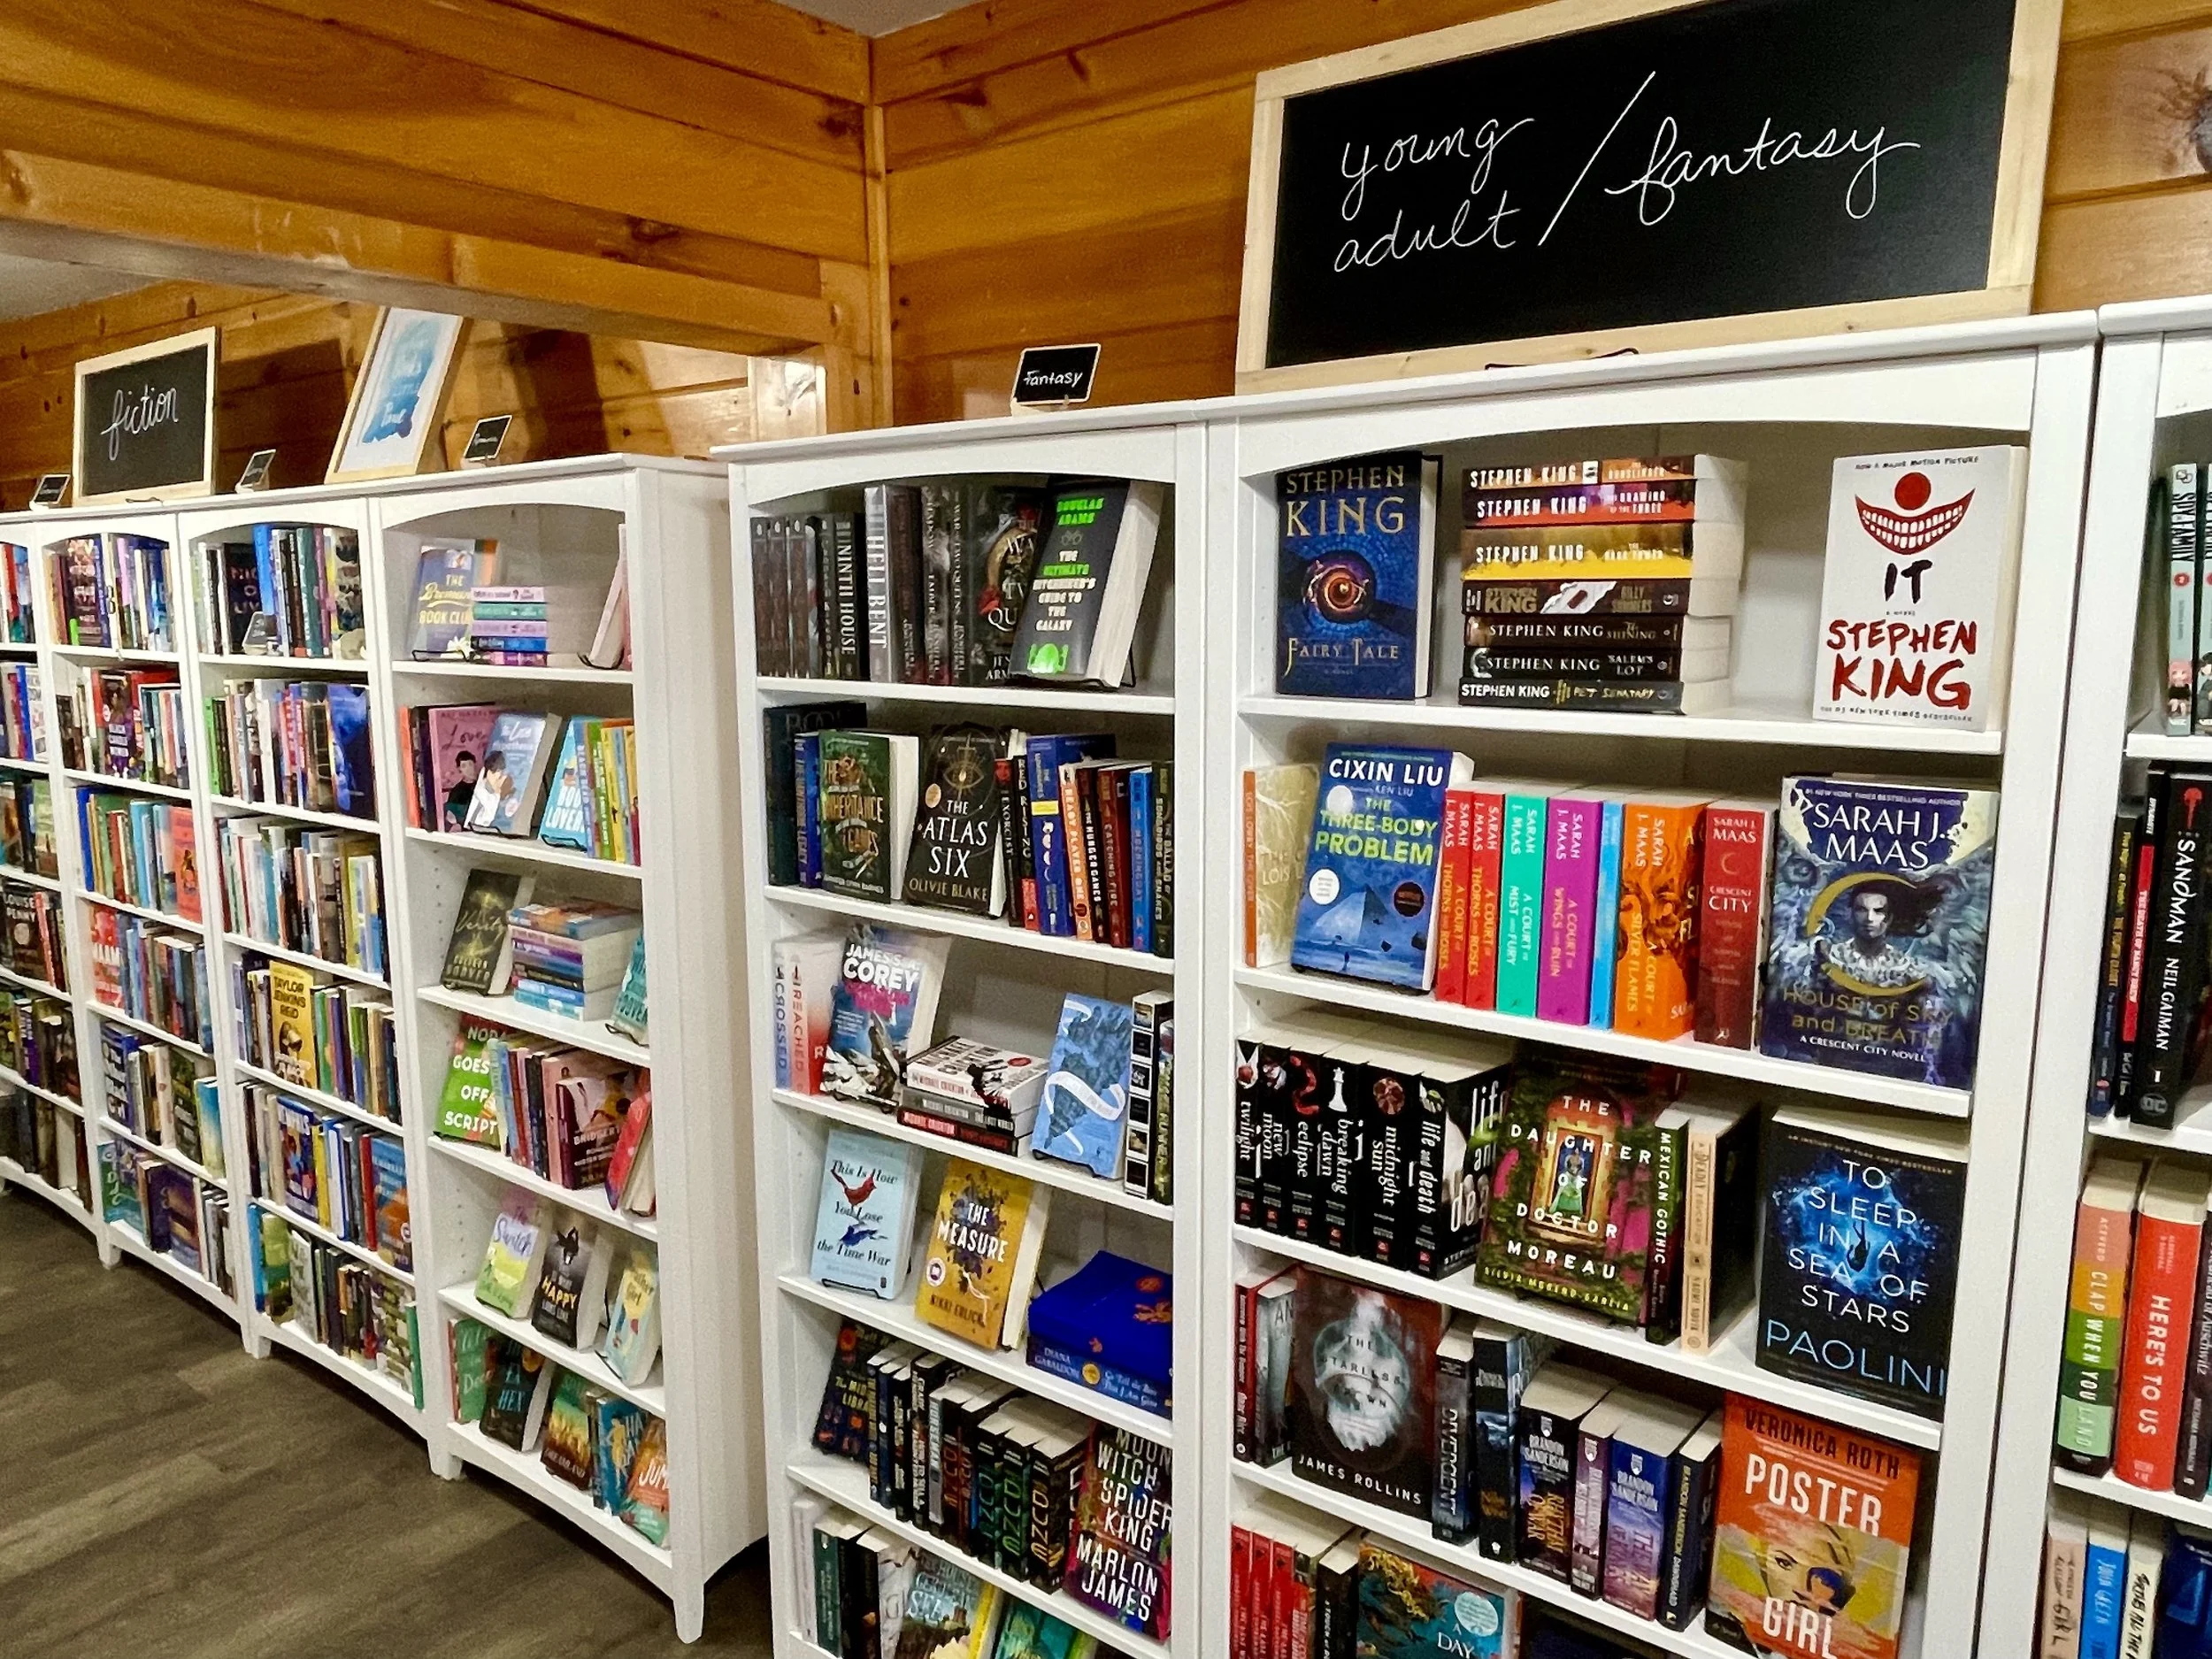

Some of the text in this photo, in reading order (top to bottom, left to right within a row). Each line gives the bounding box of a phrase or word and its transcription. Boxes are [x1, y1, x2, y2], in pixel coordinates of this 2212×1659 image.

[1341, 117, 1535, 220] young
[1605, 115, 1921, 226] fantasy
[1333, 201, 1520, 273] adult
[100, 383, 179, 460] fiction
[1286, 465, 1405, 495] STEPHEN
[1471, 465, 1576, 488] STEPHEN KING
[1057, 498, 1104, 512] DOUGLAS
[1058, 513, 1095, 526] ADAMS
[1286, 496, 1405, 539] KING
[1477, 495, 1587, 518] STEPHEN KING
[1059, 550, 1079, 562] THE
[1476, 544, 1584, 563] STEPHEN KING
[446, 574, 464, 587] THE
[837, 541, 856, 655] NINTH HOUSE
[867, 535, 887, 648] HELL BENT
[1068, 592, 1082, 603] TO
[1486, 588, 1538, 597] STEPHEN
[1884, 559, 1932, 603] IT
[419, 611, 448, 625] BOOK
[1048, 606, 1066, 617] THE
[1486, 596, 1537, 614] KING
[1036, 620, 1073, 631] GALAXY
[1489, 625, 1604, 637] STEPHEN KING
[1826, 618, 1978, 656] STEPHEN
[1486, 657, 1601, 671] STEPHEN KING
[1617, 665, 1642, 676] LOT
[1832, 653, 1971, 710] KING
[1461, 684, 1550, 697] STEPHEN KING
[1329, 758, 1444, 787] CIXIN LIU
[947, 800, 969, 815] THE
[1365, 798, 1392, 811] THE
[1713, 817, 1748, 827] SARAH
[1813, 803, 1946, 843] SARAH J.
[922, 817, 988, 847] ATLAS
[1021, 796, 1031, 857] RISING
[1320, 810, 1438, 839] THREE-BODY
[1444, 810, 1455, 848] MAAS
[1457, 803, 1470, 846] SARAH
[1473, 813, 1485, 851] MAAS
[1487, 805, 1500, 850] SARAH
[1510, 817, 1523, 856] MAAS
[1525, 809, 1538, 854] SARAH
[1555, 821, 1569, 860] MAAS
[1570, 813, 1584, 859] SARAH
[1652, 818, 1665, 867] SARAH
[1713, 829, 1756, 843] MAAS
[929, 846, 971, 878] SIX
[1315, 831, 1433, 866] PROBLEM
[1636, 826, 1648, 867] MAAS
[1824, 833, 1930, 871] MAAS
[910, 878, 987, 902] OLIVIE BLAKE
[1709, 897, 1752, 913] CITY
[1468, 866, 1483, 976] THORNS ROSES
[1507, 886, 1520, 965] MIST FURY
[845, 943, 886, 963] JAMES
[1627, 912, 1642, 1012] SILVER FLAMES
[2154, 839, 2197, 1051] SANDMAN NEIL GAIMAN
[843, 957, 918, 991] COREY
[1644, 955, 1656, 1002] COURT
[775, 979, 787, 1069] CROSSED
[792, 979, 804, 1071] REACHED
[1791, 1014, 1836, 1033] and
[453, 1055, 490, 1075] GOES
[460, 1086, 489, 1103] OFF
[1563, 1095, 1610, 1117] THE
[445, 1111, 497, 1135] SCRIPT
[1237, 1101, 1252, 1162] twilight
[1263, 1112, 1273, 1160] moon
[1273, 1122, 1285, 1156] new
[1292, 1120, 1314, 1179] eclipse
[1322, 1131, 1338, 1177] dawn
[1331, 1118, 1354, 1194] breaking
[1371, 1140, 1384, 1171] sun
[1510, 1124, 1651, 1164] DAUGHTER
[832, 1159, 854, 1175] This
[856, 1165, 867, 1178] Is
[1379, 1125, 1402, 1207] midnight
[1557, 1175, 1587, 1188] OF
[1843, 1159, 1886, 1189] TO
[834, 1201, 883, 1222] You Lose
[967, 1202, 990, 1226] THE
[1653, 1132, 1671, 1264] MEXICAN GOTHIC
[1809, 1187, 1916, 1230] SLEEP
[1517, 1202, 1617, 1239] DOCTOR
[817, 1240, 891, 1267] the Time War
[937, 1220, 1008, 1263] MEASURE
[1507, 1240, 1616, 1279] MOREAU
[1819, 1222, 1901, 1264] IN A
[541, 1276, 578, 1310] HAPPY
[1788, 1248, 1930, 1302] SEA OF
[2088, 1271, 2109, 1312] CLAP
[1801, 1285, 1910, 1333] STARS
[1766, 1319, 1947, 1397] PAOLINI
[2082, 1317, 2104, 1365] WHEN
[2138, 1294, 2171, 1436] HERE'S TO US
[2079, 1370, 2100, 1402] YOU
[1744, 1409, 1901, 1479] VERONICA ROTH
[1097, 1440, 1158, 1492] WITCH
[1299, 1455, 1421, 1504] JAMES ROLLINS
[1101, 1477, 1172, 1533] SPIDER
[1745, 1453, 1882, 1537] POSTER
[1104, 1507, 1154, 1553] KING
[1076, 1533, 1158, 1596] MARLON
[1082, 1570, 1151, 1622] JAMES
[1437, 1632, 1475, 1658] DAY
[1763, 1596, 1839, 1659] GIRL
